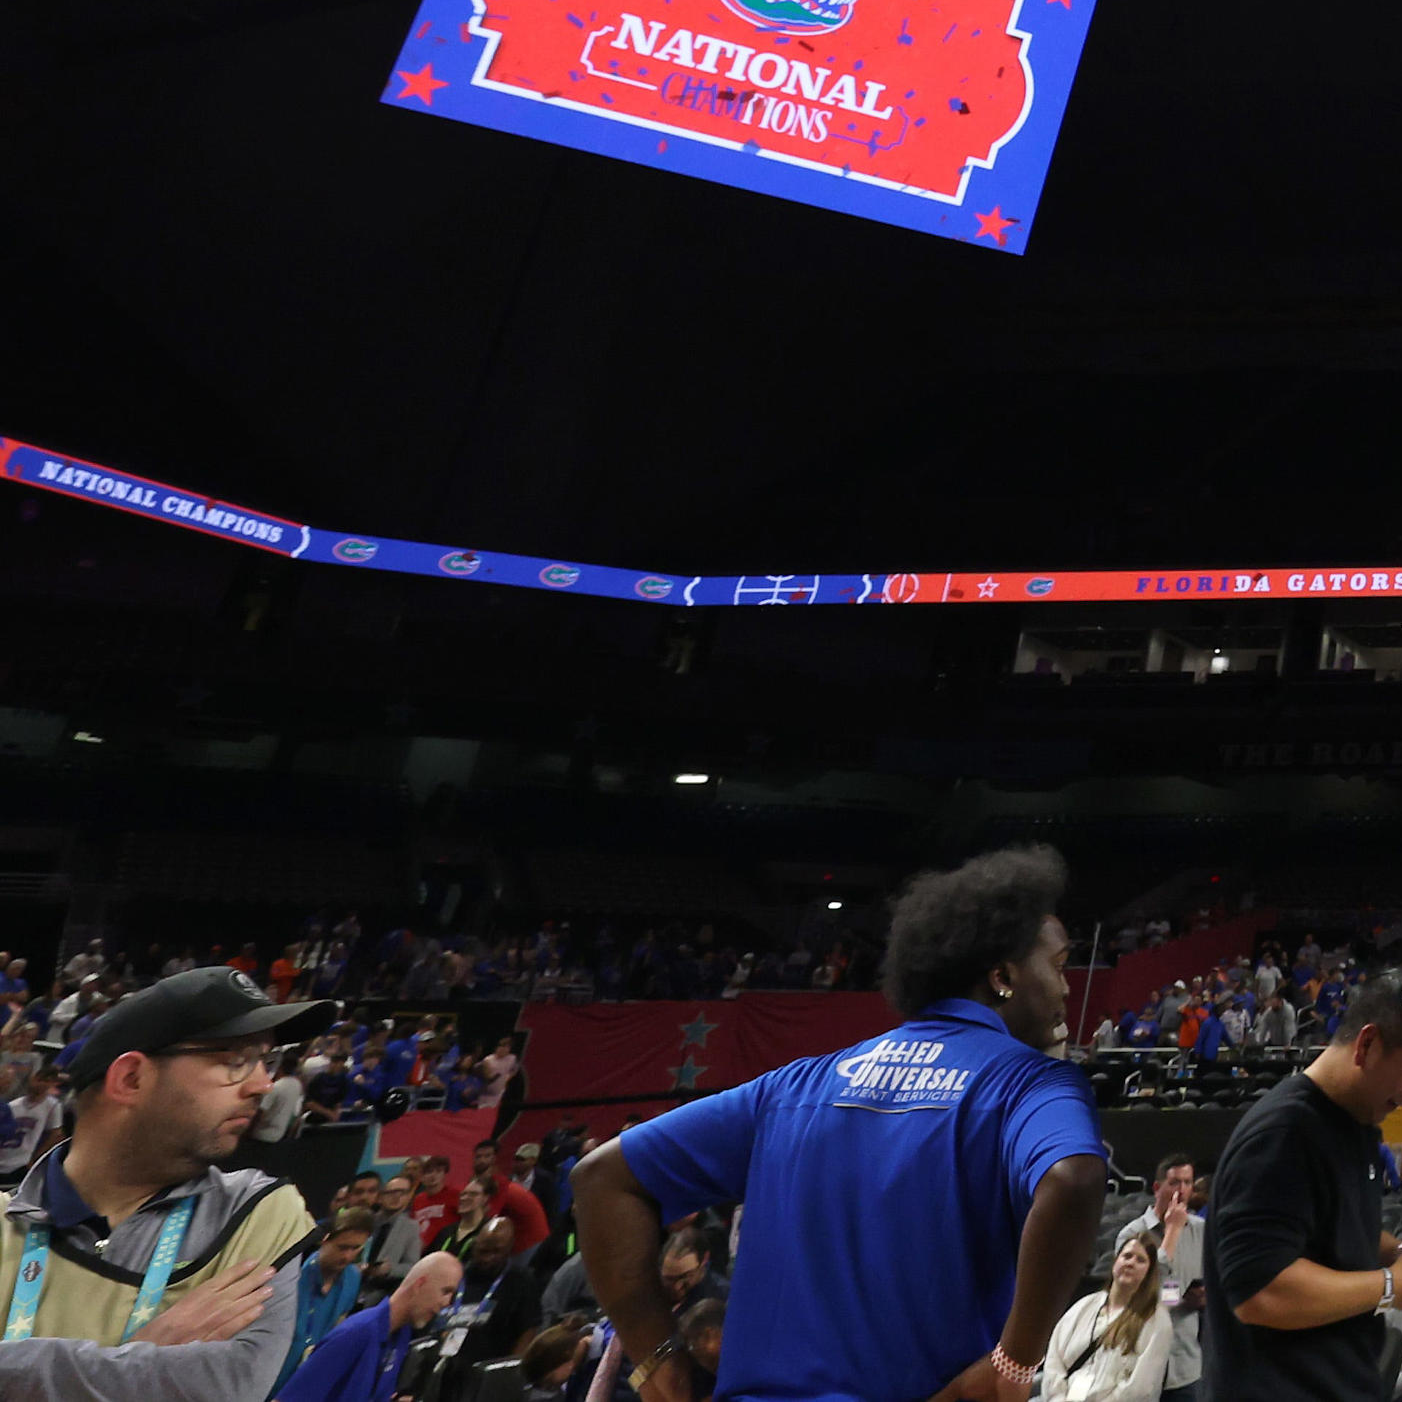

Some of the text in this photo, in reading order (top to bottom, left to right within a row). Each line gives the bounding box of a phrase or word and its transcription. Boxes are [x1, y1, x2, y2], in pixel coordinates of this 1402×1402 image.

[610, 12, 894, 120] NATIONAL
[38, 460, 284, 544] NATIONAL CHAMPIONS
[1135, 574, 1271, 593] FLORIDA
[862, 1039, 944, 1064] ALLIED
[848, 1062, 970, 1091] UNIVERSAL
[839, 1087, 961, 1103] EVENT SERVICES
